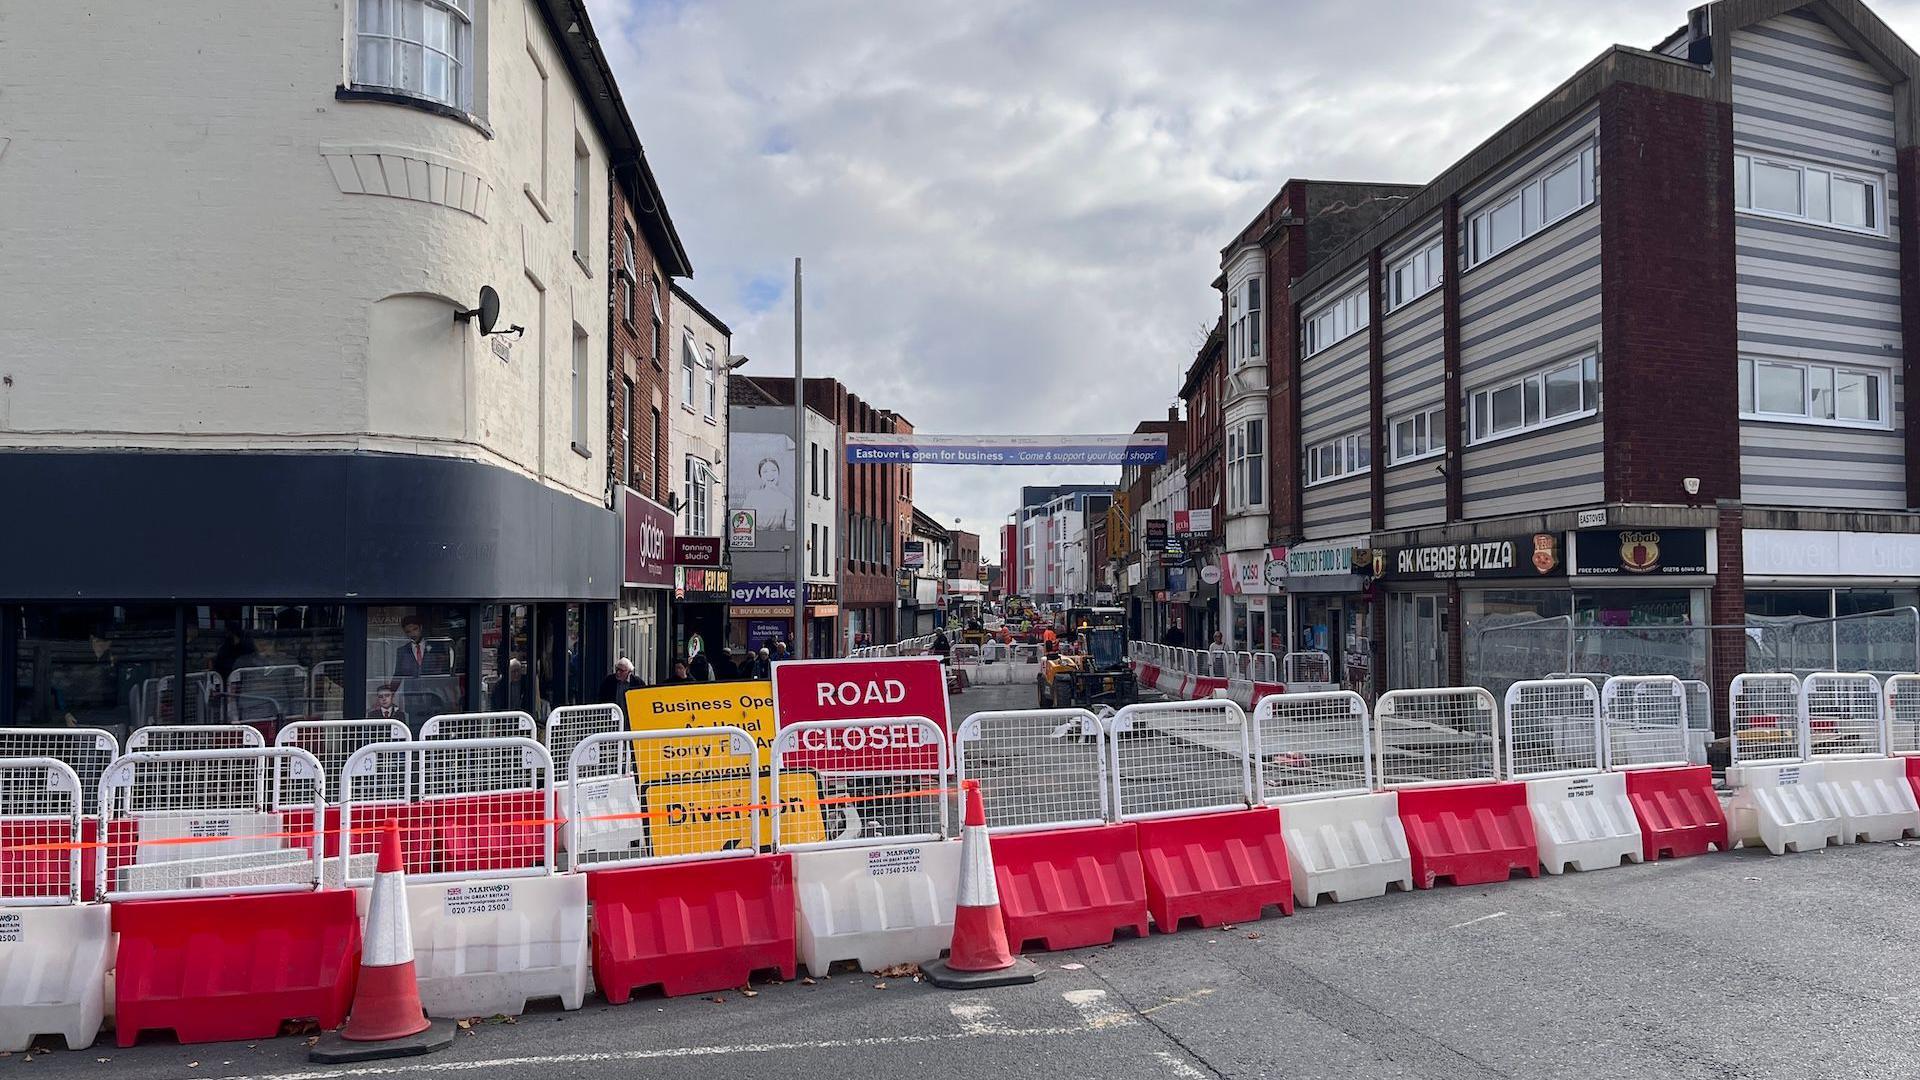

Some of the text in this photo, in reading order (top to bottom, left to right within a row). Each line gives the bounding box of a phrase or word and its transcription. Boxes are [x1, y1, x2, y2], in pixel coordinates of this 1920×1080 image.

[856, 449, 898, 458] Eastover
[902, 450, 910, 458] is
[912, 450, 938, 462] open
[941, 450, 956, 460] for
[958, 450, 1004, 460] business
[1053, 452, 1085, 463] support
[1087, 452, 1106, 463] your
[1108, 451, 1128, 460] local
[1620, 531, 1660, 543] Kebab
[682, 544, 712, 553] tanning
[685, 552, 710, 560] studio
[1398, 542, 1513, 572] AK KEBAB & PIZZA
[1319, 550, 1334, 571] FOOD
[817, 680, 906, 706] ROAD
[652, 696, 773, 714] Business Ope
[803, 724, 924, 751] CLOSED
[664, 744, 710, 759] Sorry
[666, 796, 805, 826] Diverion
